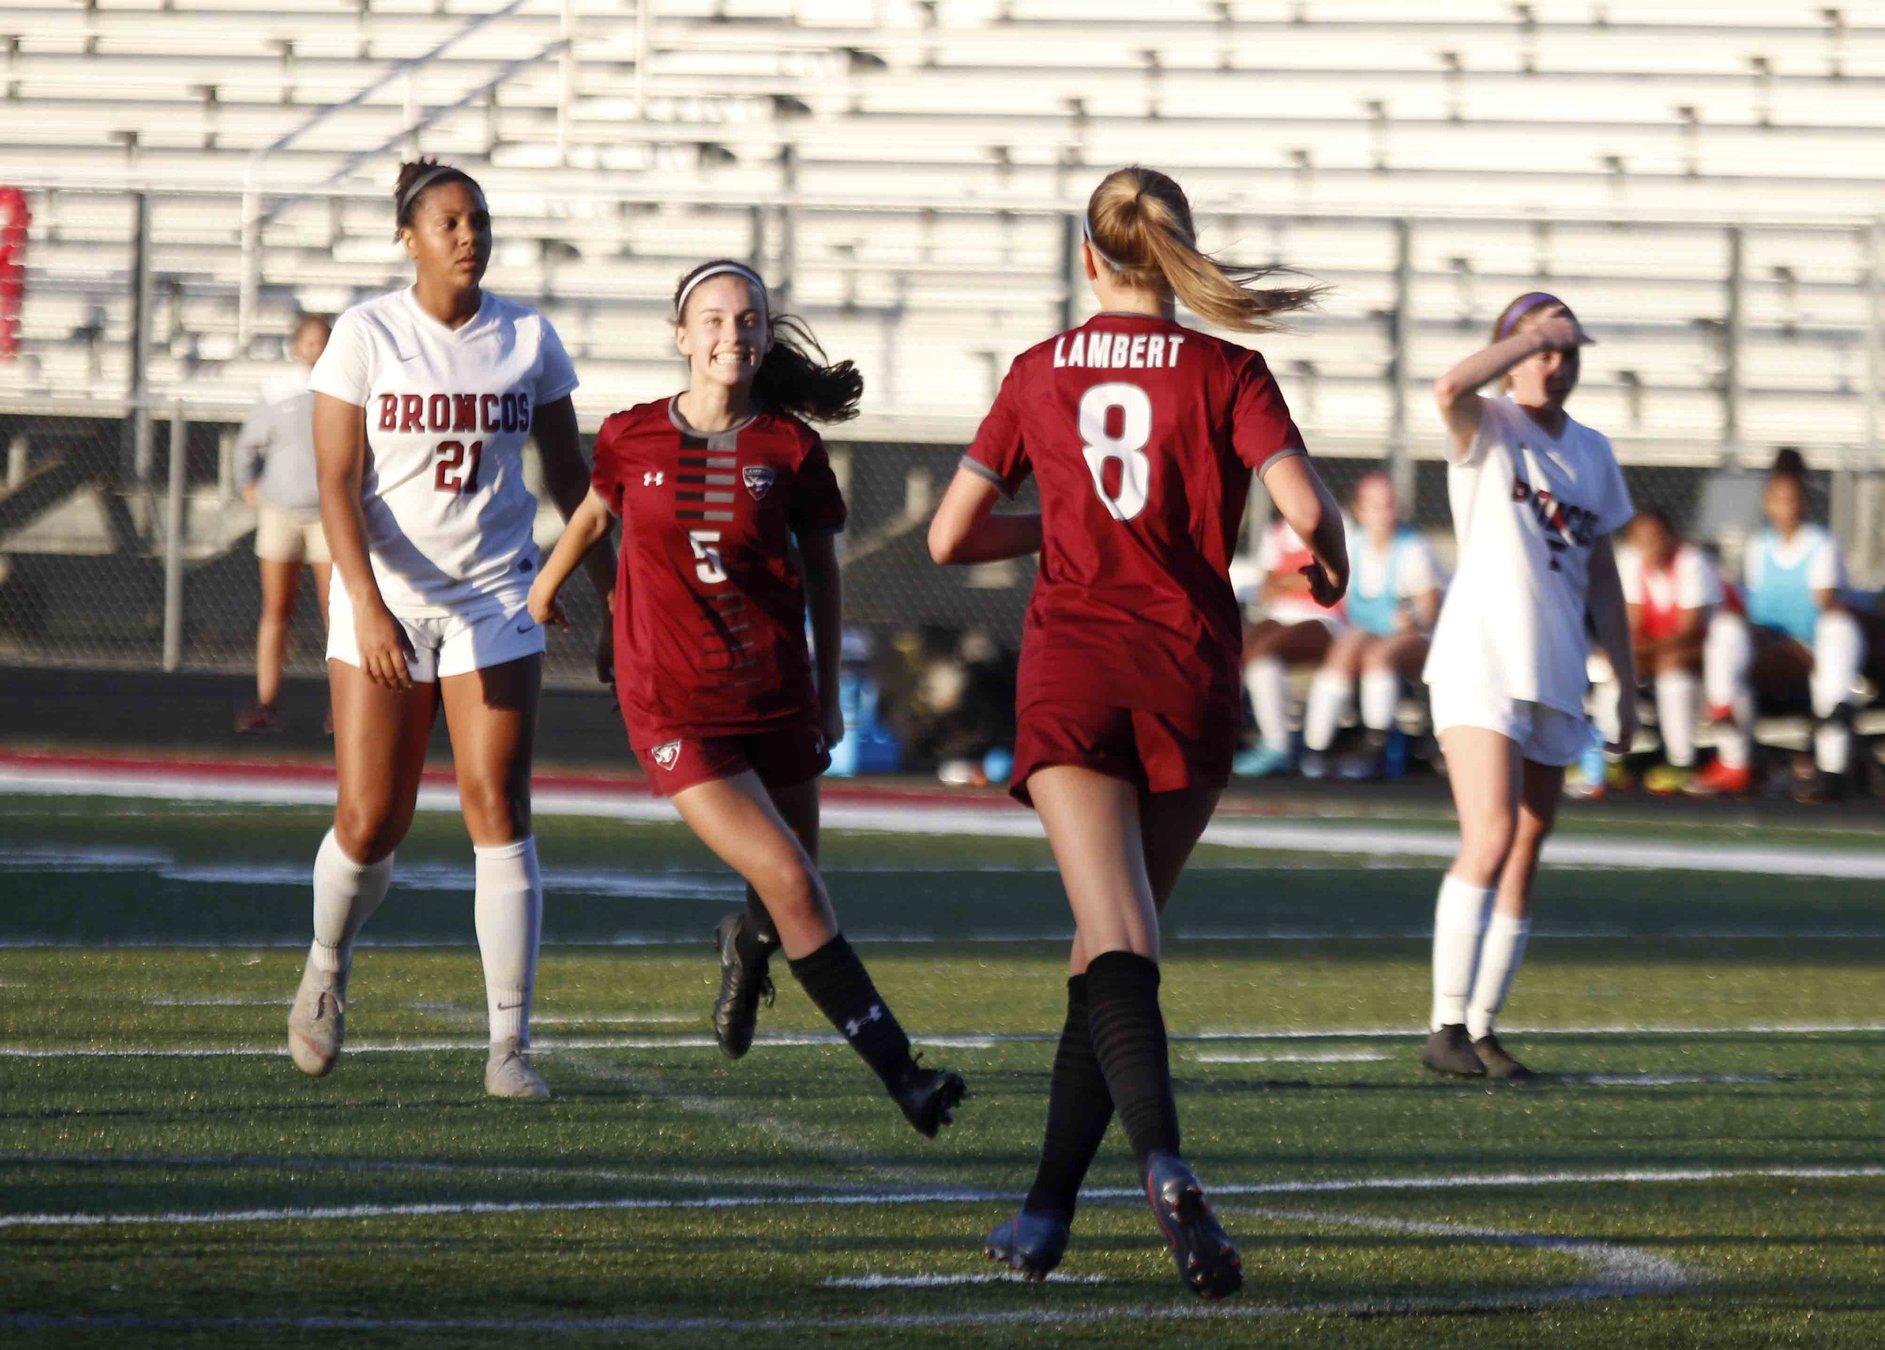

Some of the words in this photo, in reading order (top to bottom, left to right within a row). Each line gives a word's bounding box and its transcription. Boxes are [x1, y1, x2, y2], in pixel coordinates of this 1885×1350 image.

[1053, 332, 1184, 368] LAMBERT
[378, 393, 529, 433] BRONCOS
[434, 440, 483, 494] 21
[1078, 382, 1152, 521] 8
[689, 530, 727, 584] 5
